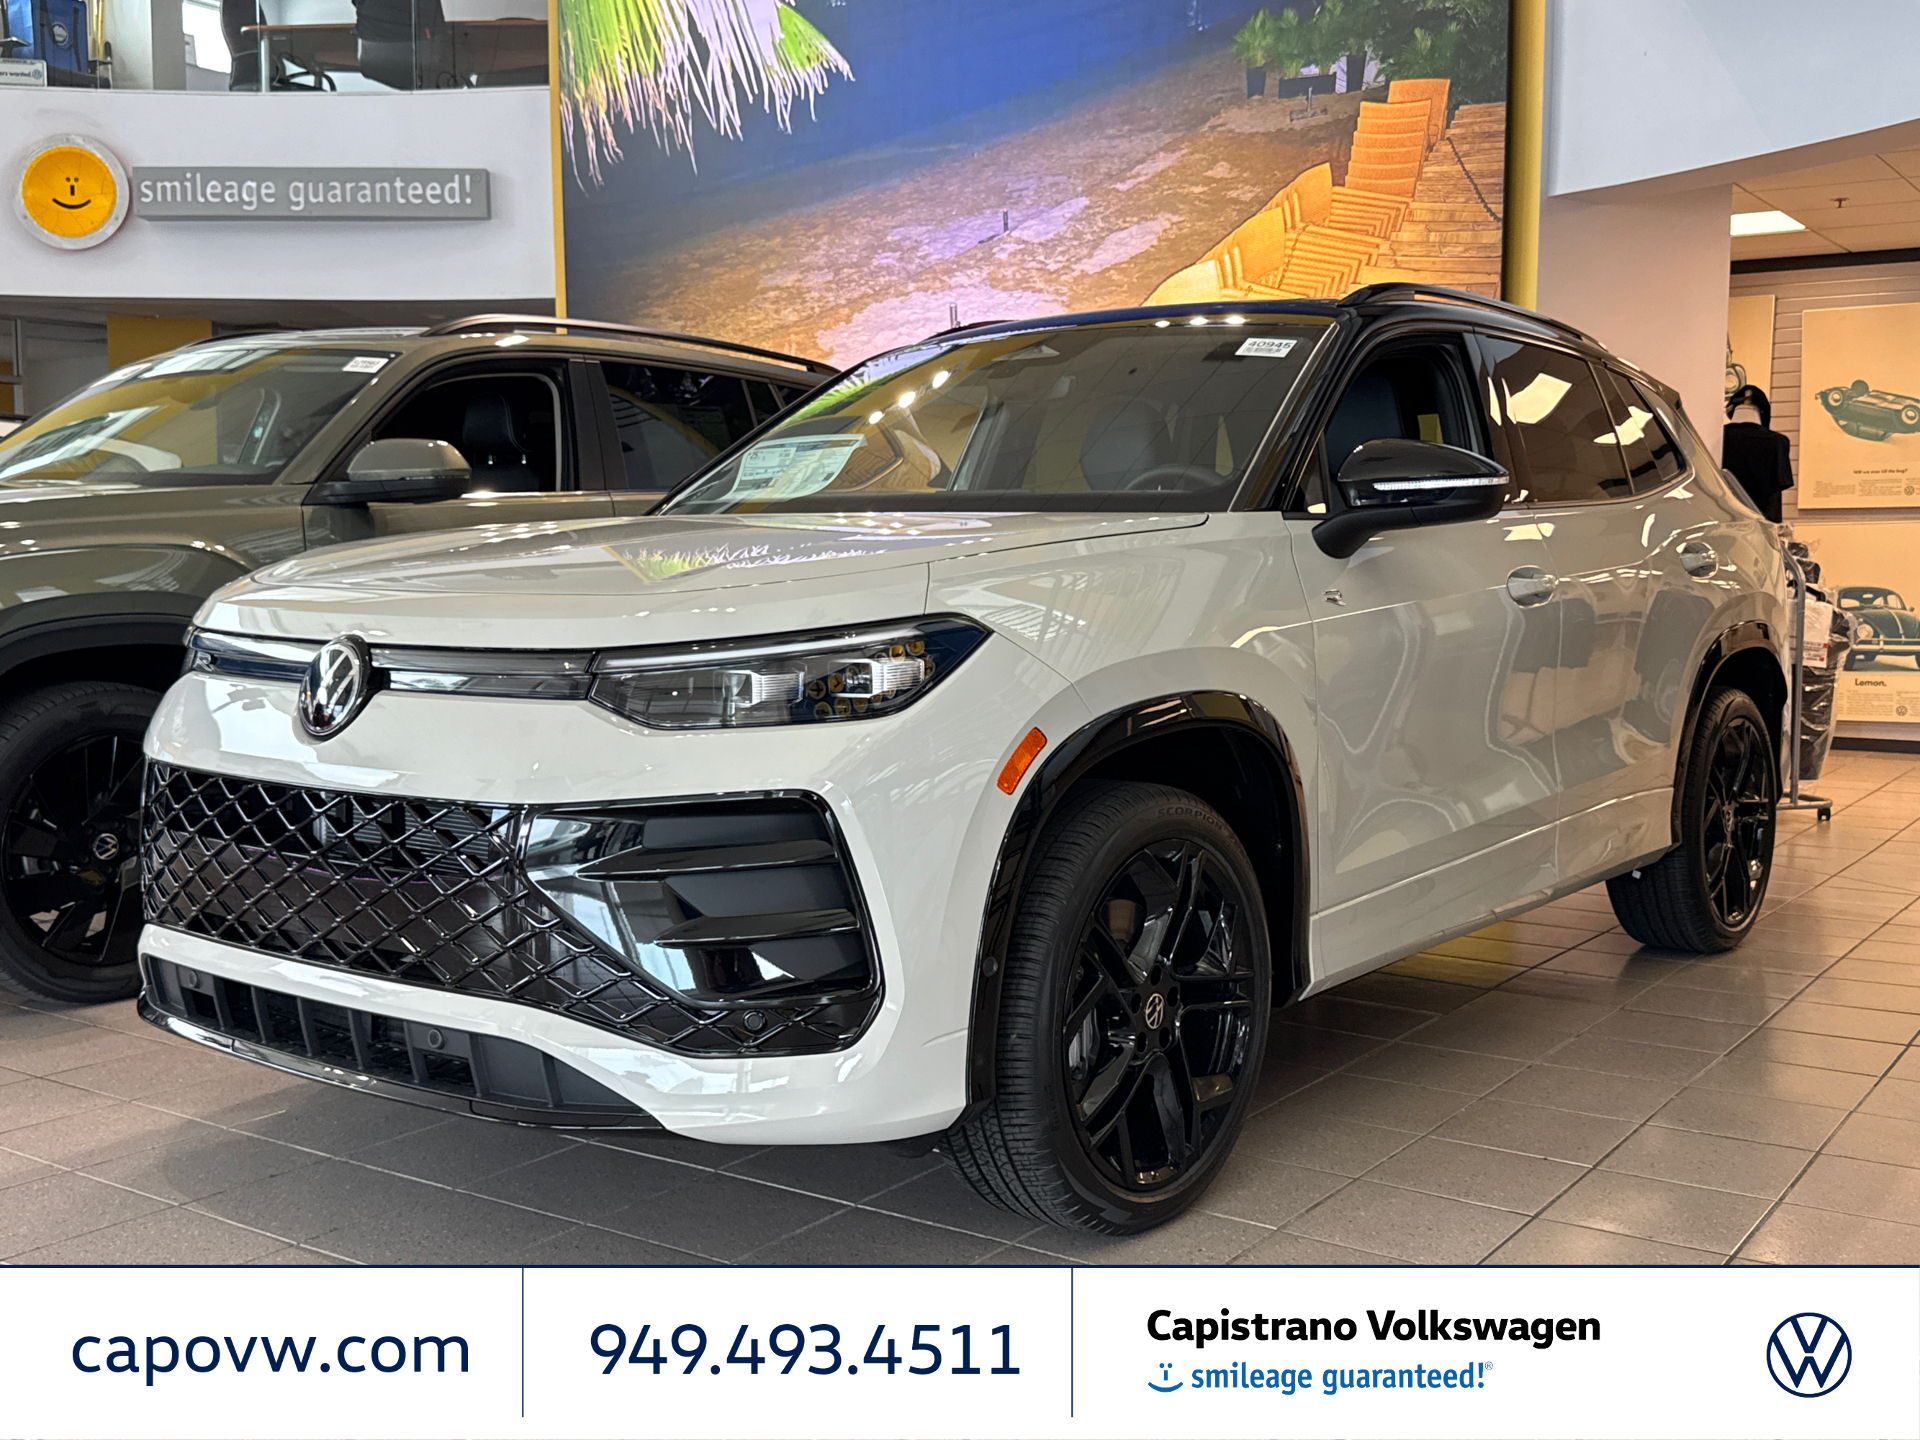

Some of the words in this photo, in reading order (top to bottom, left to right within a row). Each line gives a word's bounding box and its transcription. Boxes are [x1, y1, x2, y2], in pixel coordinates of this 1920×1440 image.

[139, 172, 276, 211] smileage
[289, 173, 473, 211] guaranteed!
[1854, 678, 1887, 687] Lemon.
[1158, 806, 1223, 830] SCORPION
